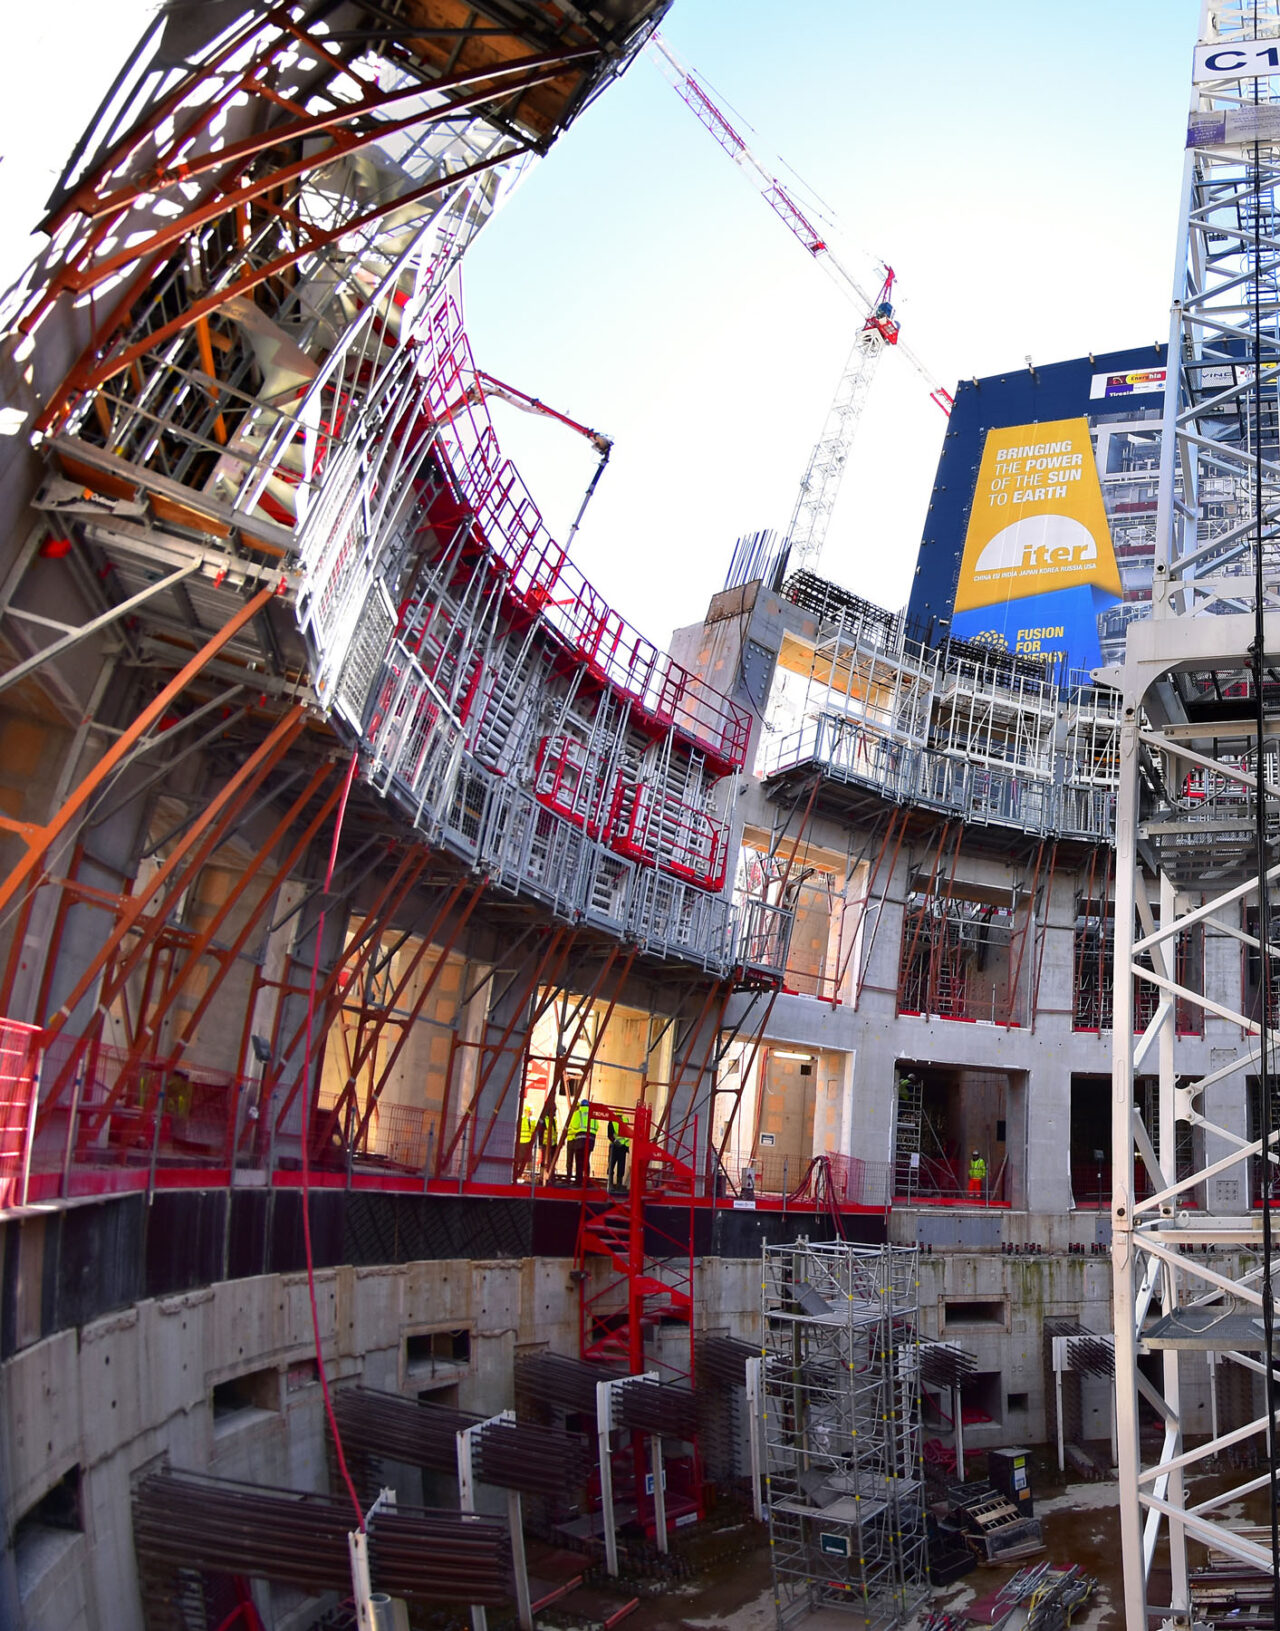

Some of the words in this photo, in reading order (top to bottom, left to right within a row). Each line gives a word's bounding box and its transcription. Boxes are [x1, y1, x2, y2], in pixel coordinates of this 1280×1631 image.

[1205, 47, 1279, 71] C1
[997, 440, 1072, 461] BRINGING
[995, 461, 1021, 476] THE
[1026, 453, 1083, 472] POWER
[991, 477, 1011, 491] OF
[1016, 473, 1043, 487] THE
[1048, 468, 1082, 484] SUN
[989, 492, 1008, 507] TO
[1013, 485, 1067, 503] EARTH
[1021, 544, 1088, 567] iter
[974, 574, 991, 582] CHINA
[1001, 570, 1017, 578] INDIA
[1019, 568, 1039, 576] JAPAN
[1017, 626, 1064, 641] FUSION
[1016, 641, 1041, 653] FOR
